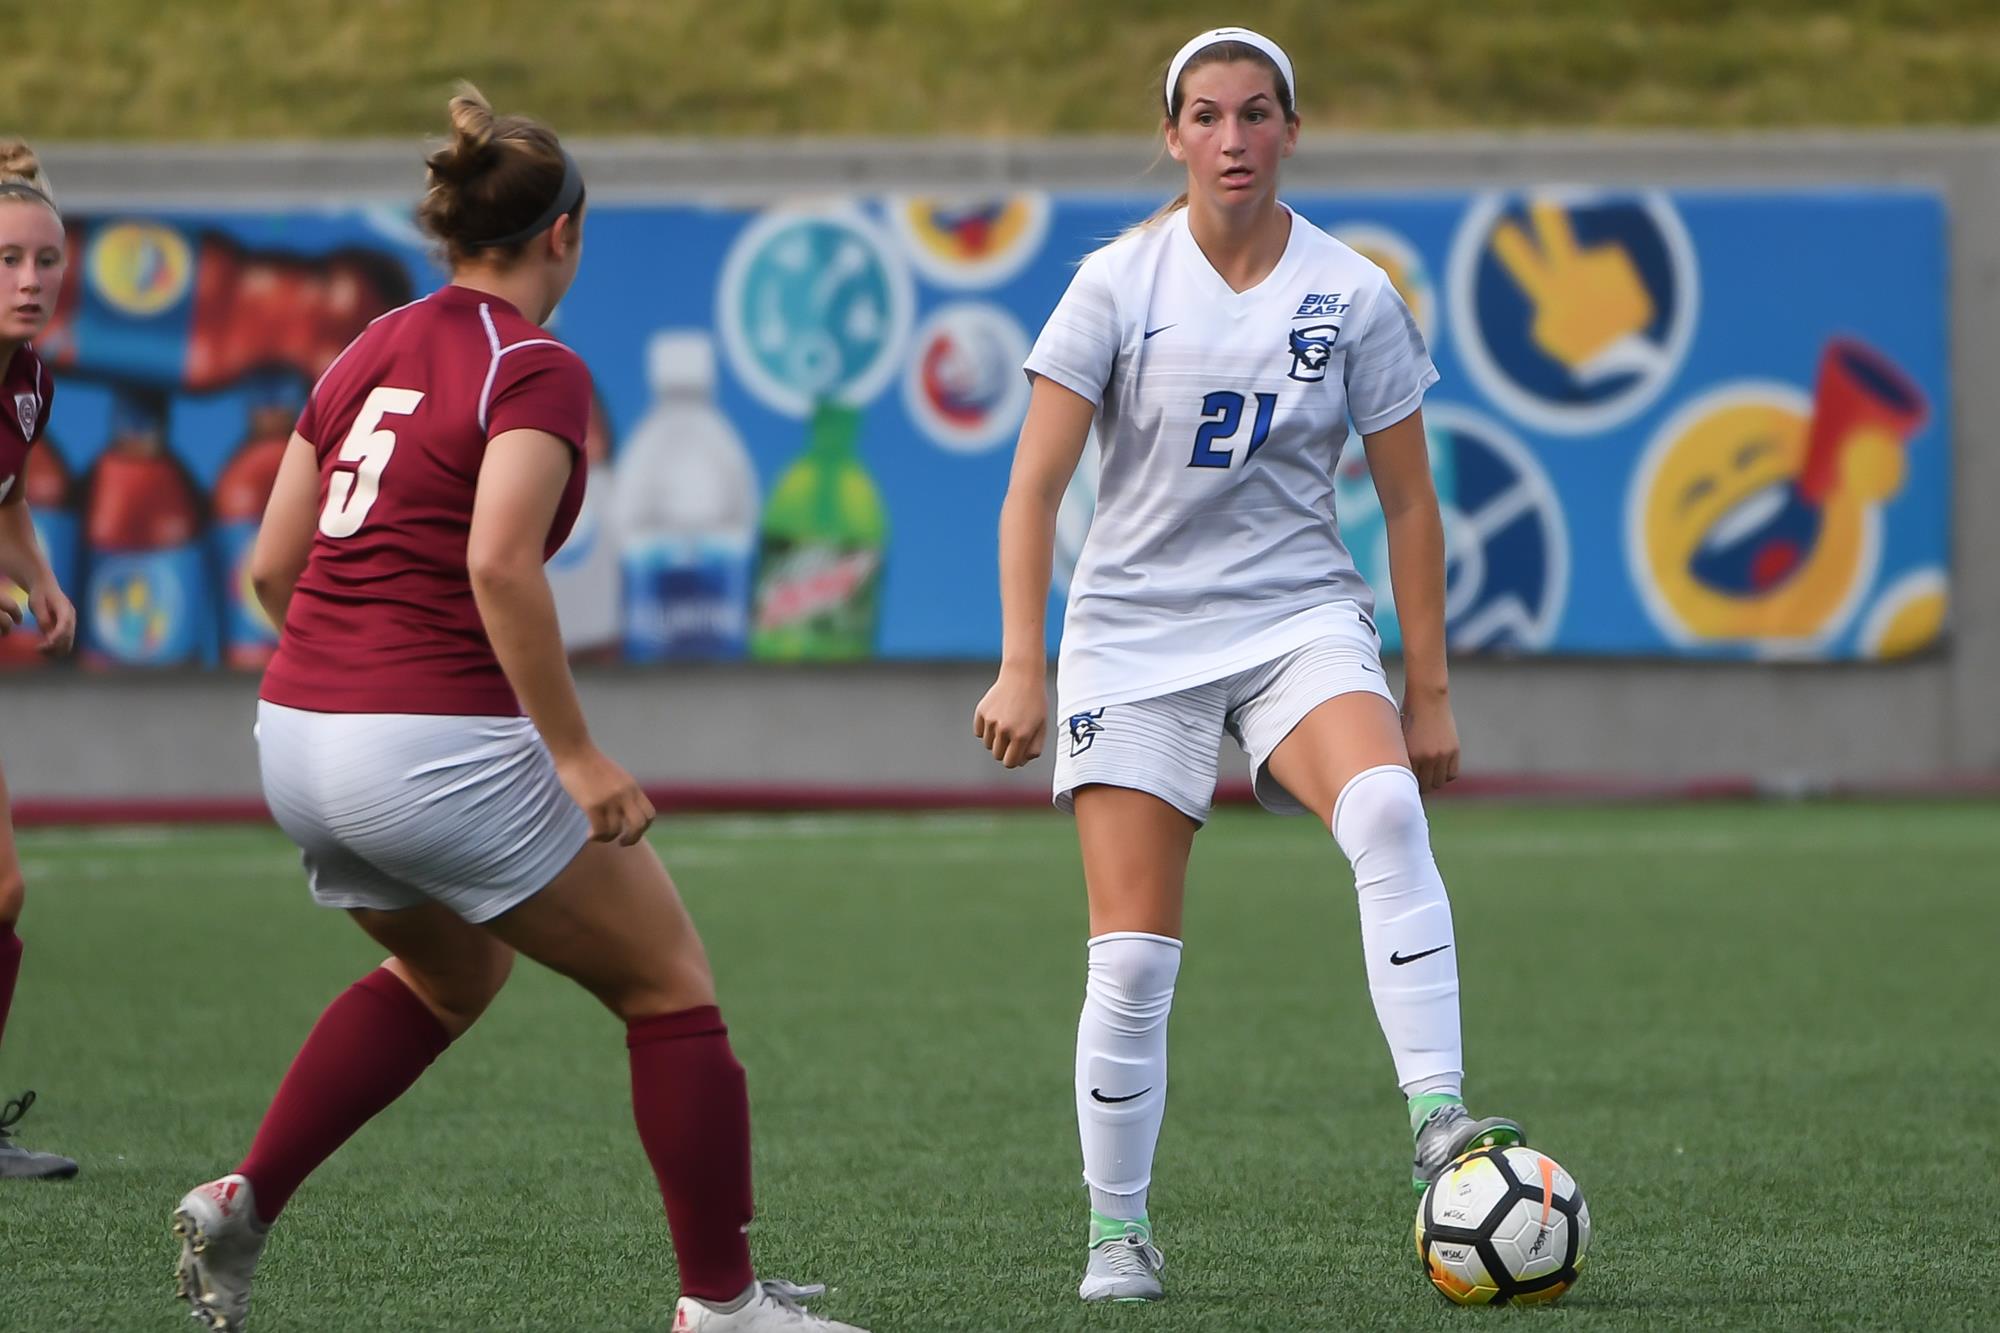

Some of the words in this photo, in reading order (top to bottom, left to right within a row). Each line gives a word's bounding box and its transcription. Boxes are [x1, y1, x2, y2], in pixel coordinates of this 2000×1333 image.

[1296, 304, 1350, 314] EAST
[1302, 293, 1341, 305] BIG
[1186, 390, 1278, 469] 21
[318, 386, 426, 538] 5
